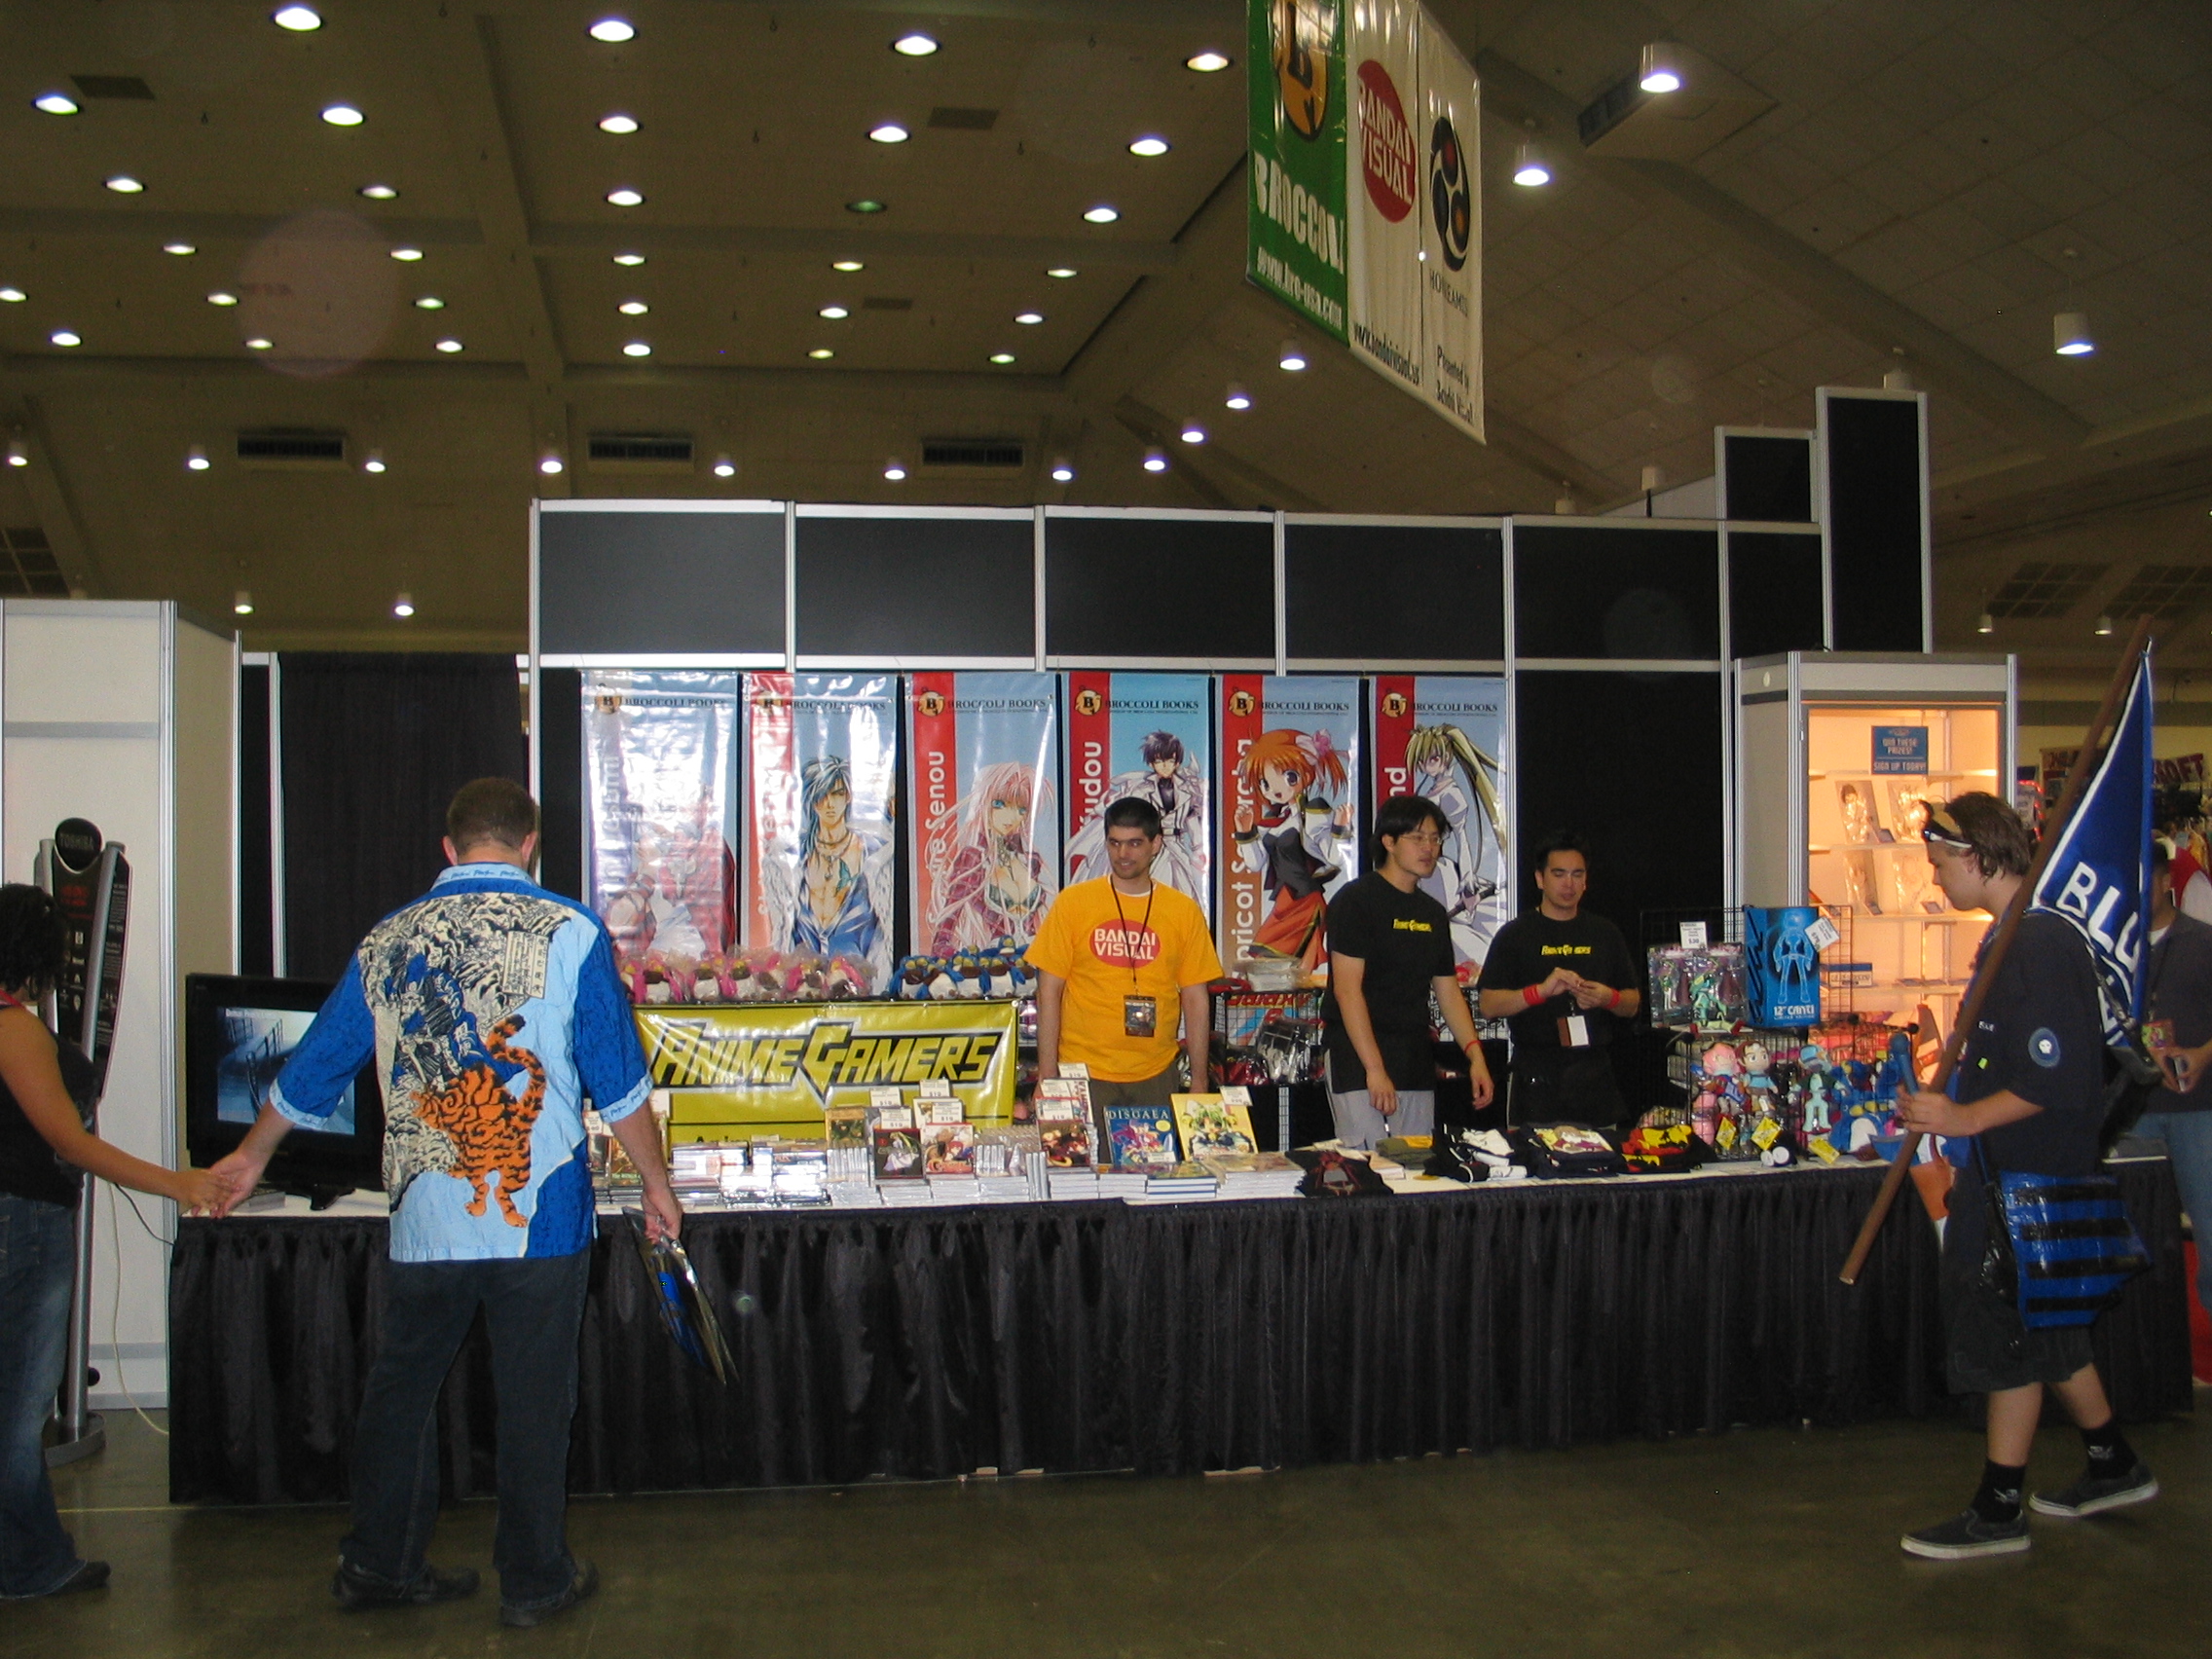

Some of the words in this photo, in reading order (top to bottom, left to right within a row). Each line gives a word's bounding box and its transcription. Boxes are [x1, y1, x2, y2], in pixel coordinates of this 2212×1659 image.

[1357, 77, 1412, 166] BANDAI
[1363, 122, 1413, 207] VISUAL
[1254, 149, 1345, 276] BROCCOLI
[949, 699, 1006, 710] BROCCOLI
[1009, 698, 1047, 710] BOOKS
[1106, 700, 1160, 710] BROCCOLI
[1162, 700, 1199, 710] BOOKS
[1261, 701, 1310, 711] BROCCOLI
[1313, 702, 1350, 712] BOOKS
[1412, 702, 1461, 713] BROCCOLI
[1463, 703, 1498, 713] BOOKS
[925, 751, 946, 830] Senou
[1079, 741, 1102, 833] udou
[1094, 928, 1156, 946] BANDAI
[1094, 941, 1155, 961] VISUAL
[1109, 1108, 1169, 1120] DISGAEA
